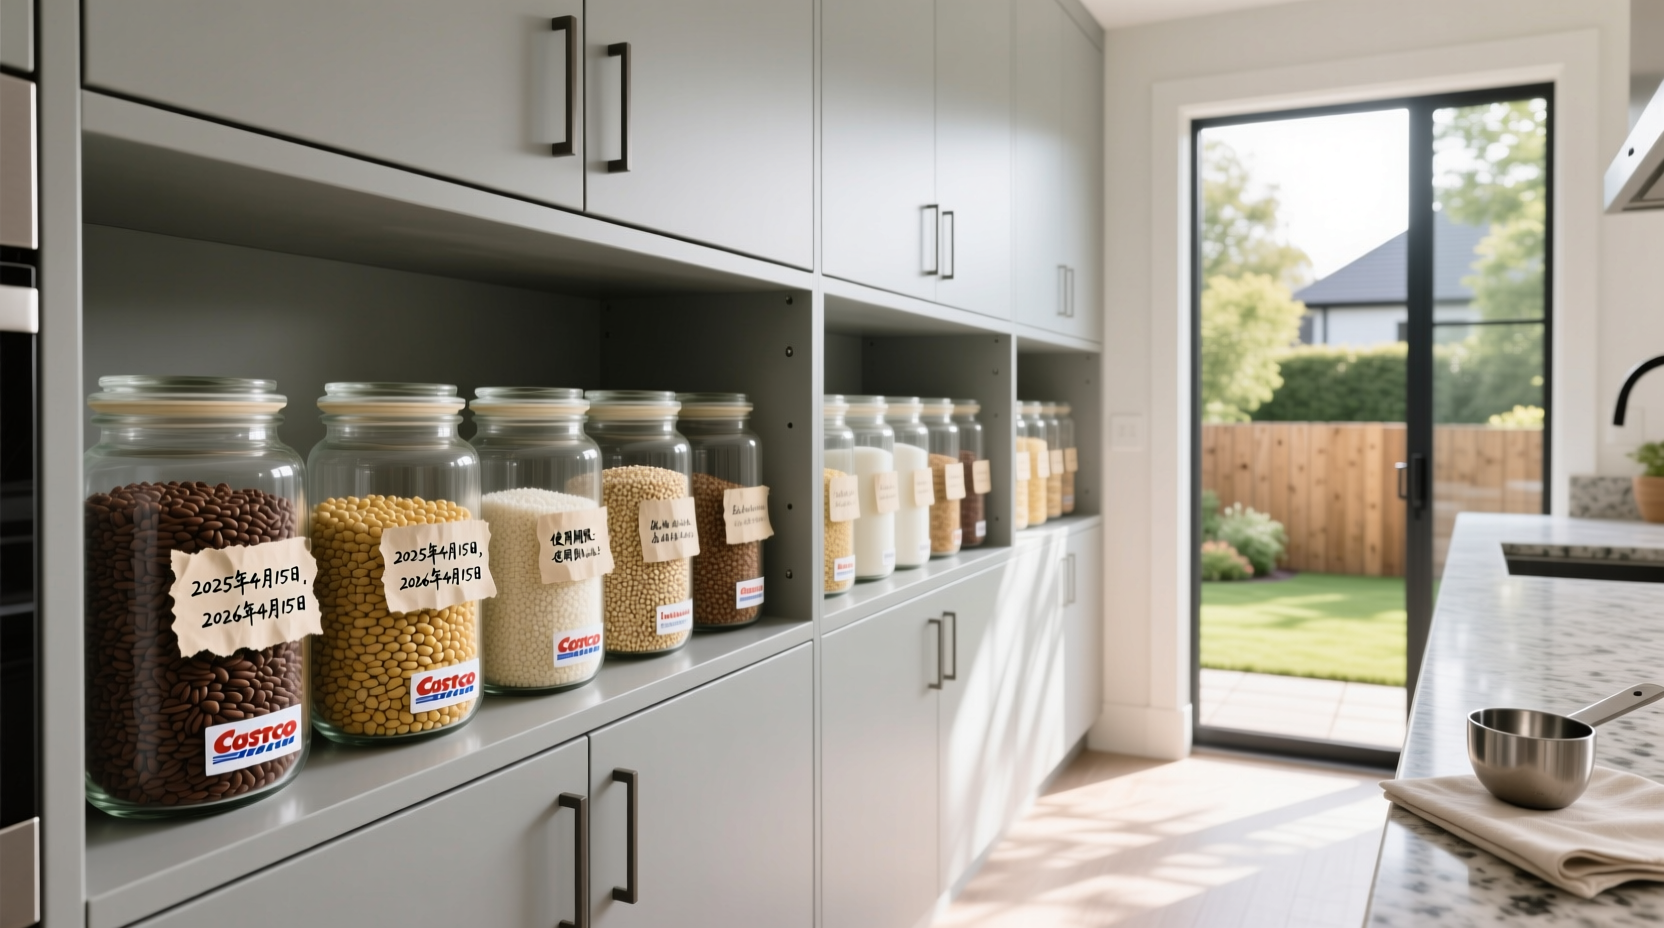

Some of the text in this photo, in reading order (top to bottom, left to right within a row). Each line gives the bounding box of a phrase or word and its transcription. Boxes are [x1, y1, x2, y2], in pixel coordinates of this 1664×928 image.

[399, 566, 482, 591] 2026年4月15日
[201, 595, 306, 627] 2026年4月15日
